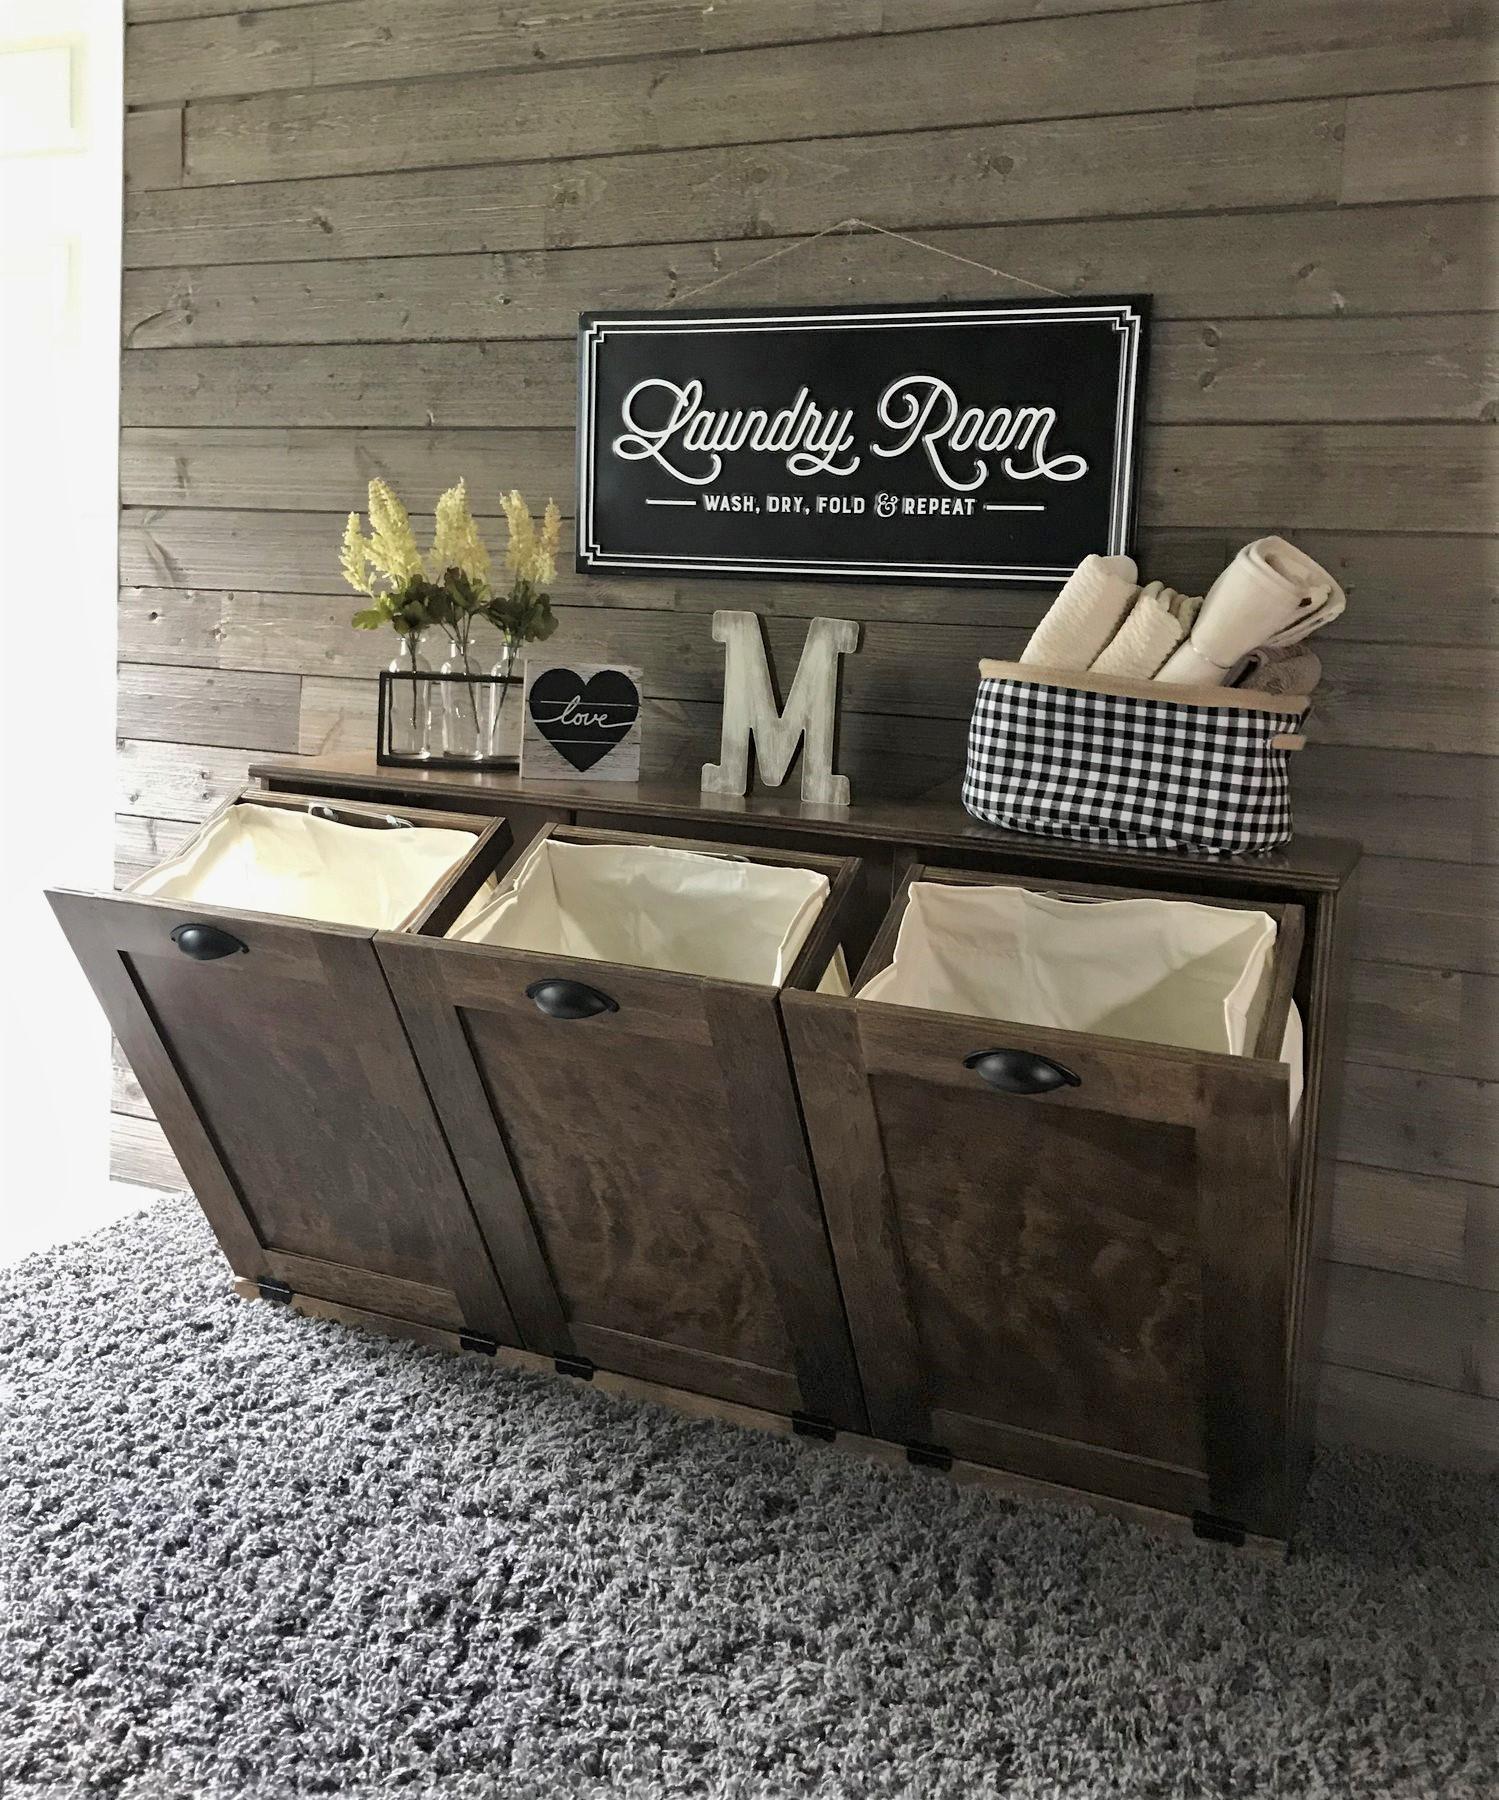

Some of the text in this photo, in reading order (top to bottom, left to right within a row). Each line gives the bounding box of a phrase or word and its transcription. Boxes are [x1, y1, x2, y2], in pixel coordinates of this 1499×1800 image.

[613, 375, 1089, 491] Laundry Room
[704, 492, 976, 518] WASH, DRY, FOLD & REPEAT
[534, 694, 635, 728] love
[701, 609, 860, 806] M
